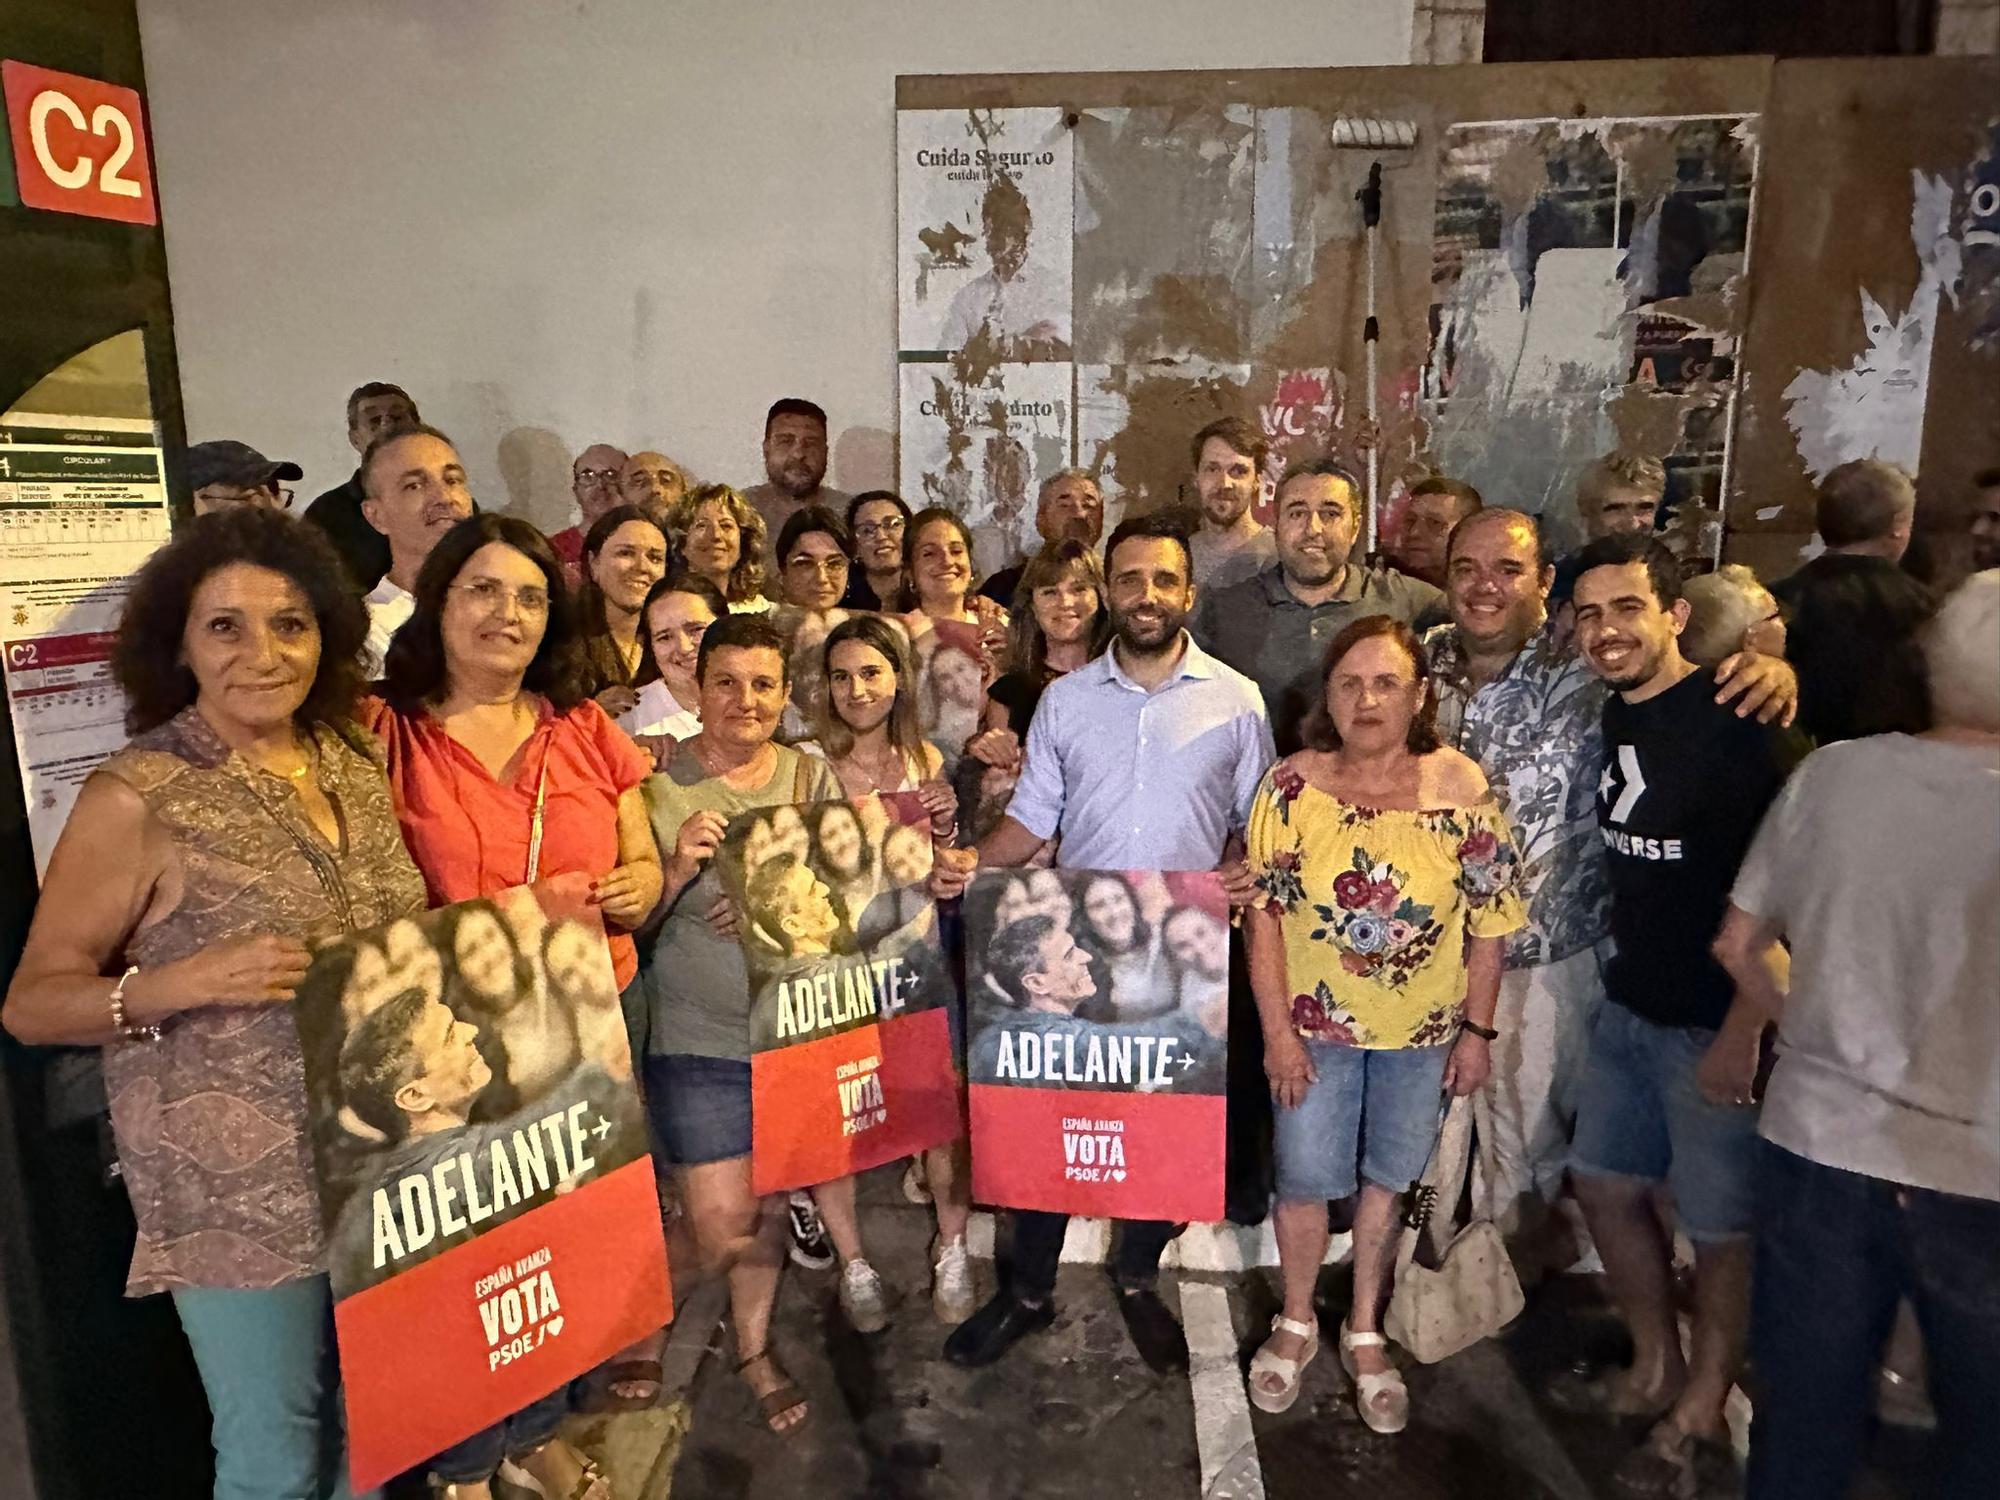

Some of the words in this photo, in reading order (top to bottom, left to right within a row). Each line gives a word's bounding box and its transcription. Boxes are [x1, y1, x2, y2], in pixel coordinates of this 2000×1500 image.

[30, 90, 142, 198] C2
[917, 147, 970, 167] Cuida
[10, 643, 39, 667] C2
[1600, 826, 1682, 860] NVERSE
[776, 958, 905, 1039] ADELANTE
[996, 1030, 1179, 1086] ADELANTE
[838, 1072, 883, 1117] VOTA
[1063, 1132, 1125, 1167] VOTA
[373, 1101, 595, 1269] ADELANTE
[1065, 1166, 1101, 1182] PSOE
[475, 1264, 514, 1299] ESPAÑA
[515, 1247, 552, 1278] AVANZA
[479, 1270, 560, 1346] VOTA
[489, 1331, 535, 1372] PSOE
